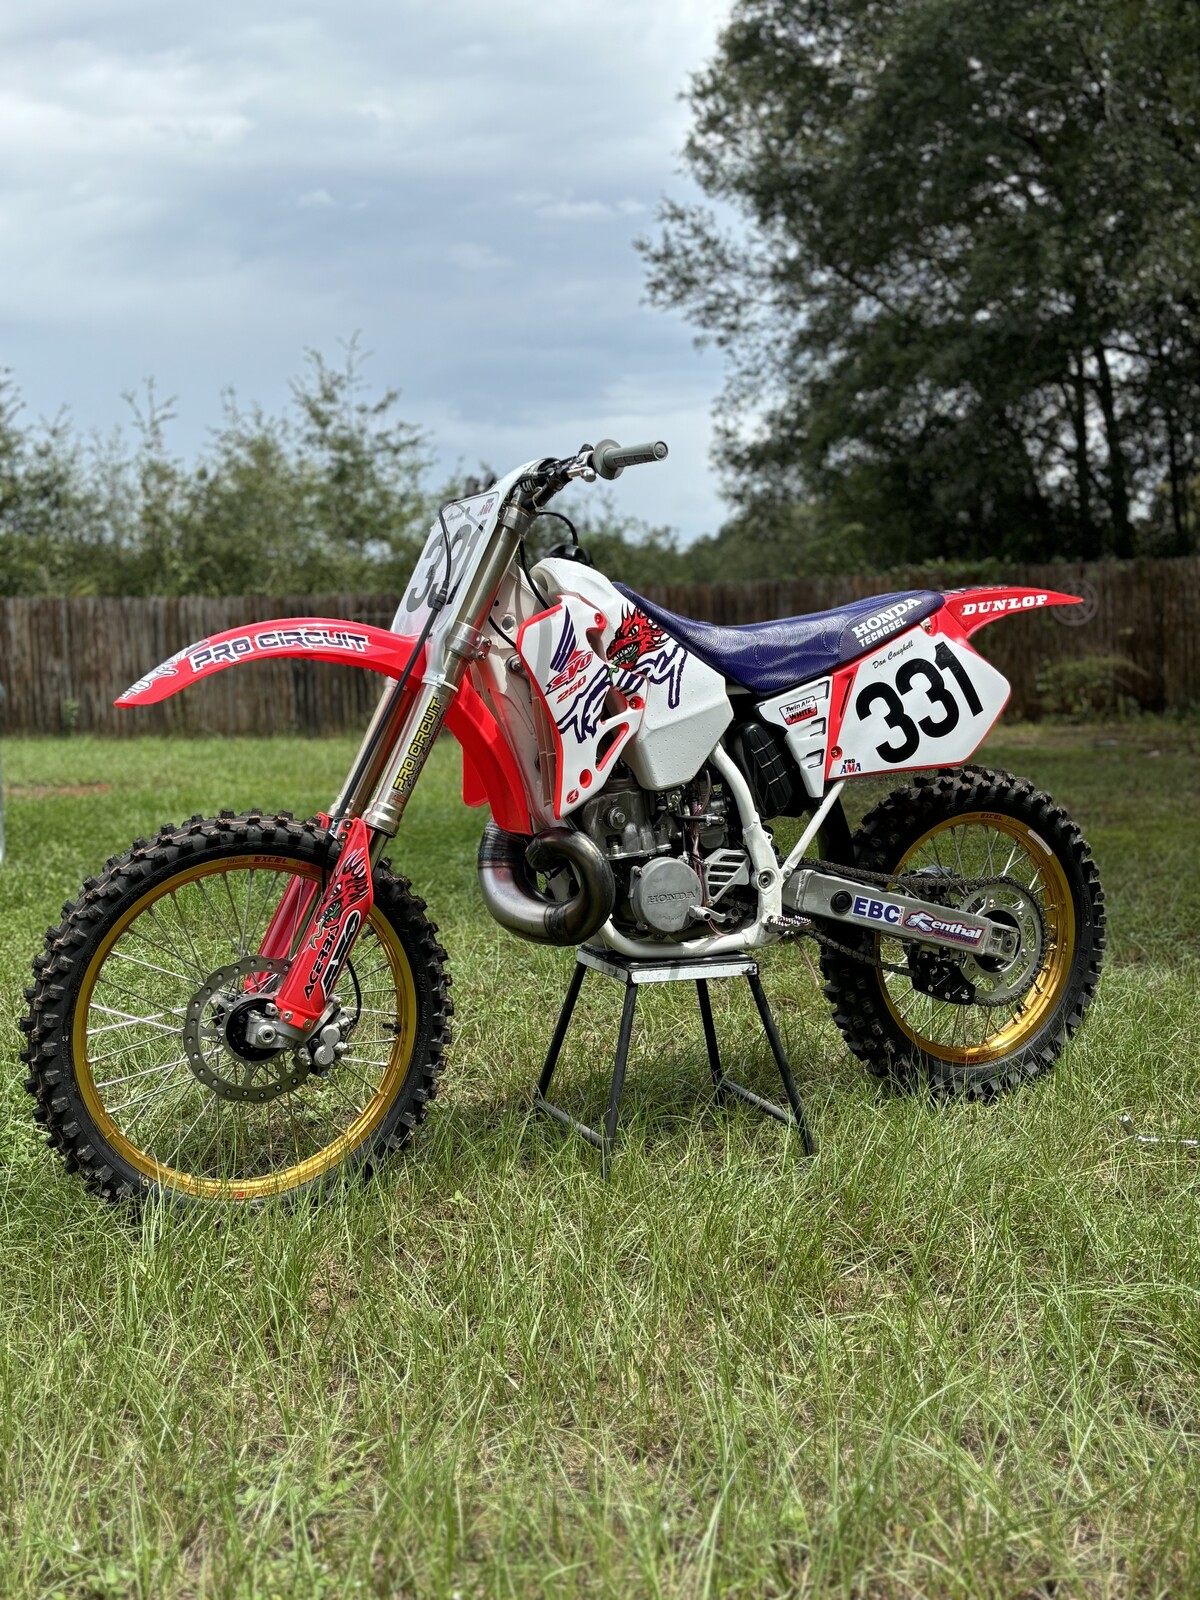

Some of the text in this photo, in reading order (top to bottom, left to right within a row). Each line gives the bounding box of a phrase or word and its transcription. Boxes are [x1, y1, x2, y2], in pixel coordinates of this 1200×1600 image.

[406, 519, 488, 612] 331
[852, 599, 922, 638] HONDA
[961, 595, 1048, 616] DUNLOP
[859, 618, 907, 647] TECNOSEL
[190, 636, 253, 672] PRO
[256, 628, 370, 653] CIRCUIT
[549, 651, 593, 692] EVO
[872, 659, 886, 669] Dan
[556, 675, 587, 704] 250
[856, 642, 983, 763] 331
[785, 703, 801, 712] Twin
[789, 707, 813, 720] WHITE
[393, 696, 441, 792] PRO CIRCUIT
[840, 763, 861, 774] AMA
[253, 855, 288, 864] EXCEL
[647, 891, 696, 904] HONDA
[853, 897, 900, 923] EBC
[905, 912, 983, 939] Renthal
